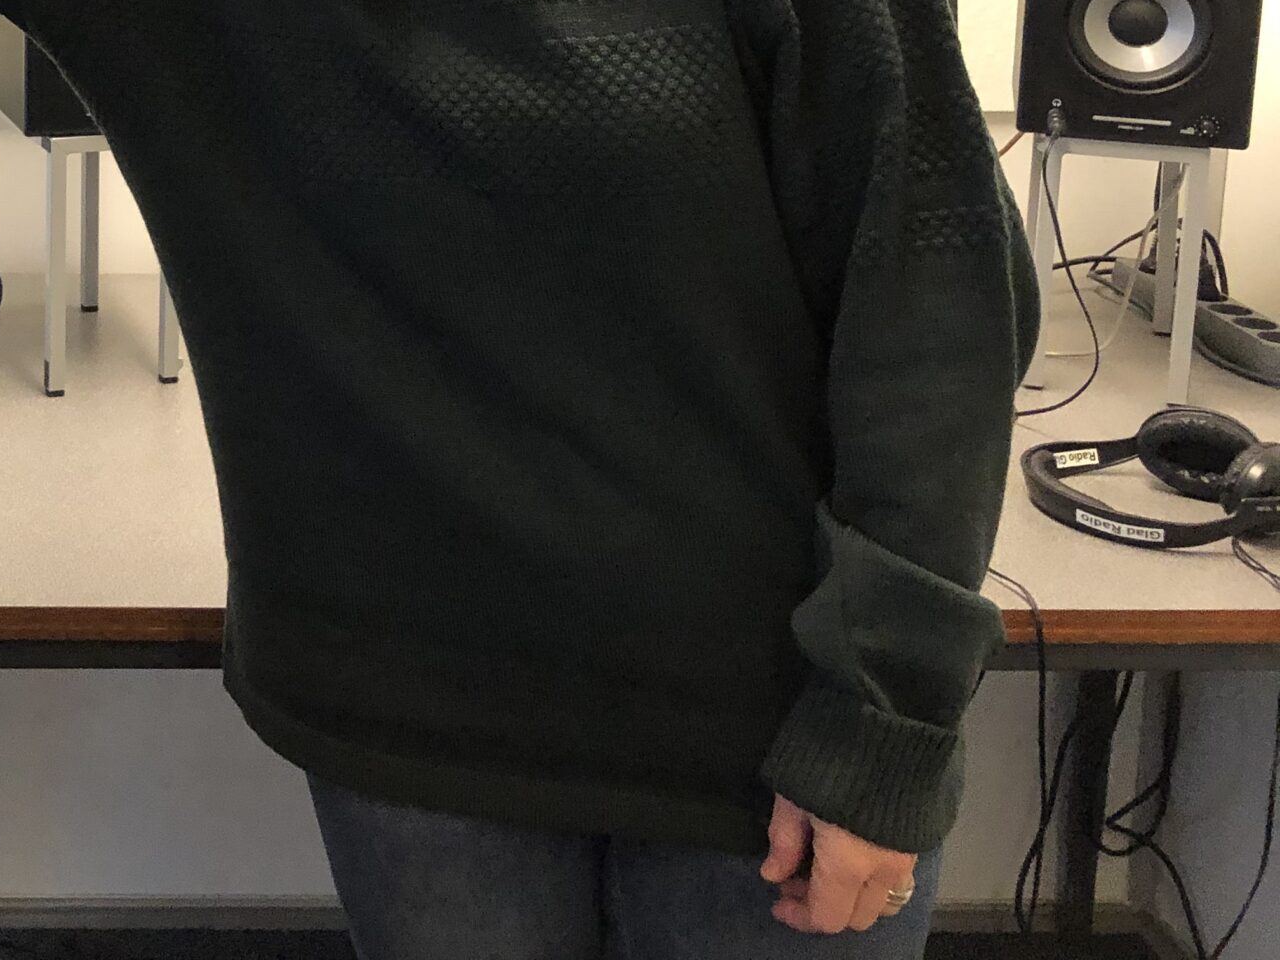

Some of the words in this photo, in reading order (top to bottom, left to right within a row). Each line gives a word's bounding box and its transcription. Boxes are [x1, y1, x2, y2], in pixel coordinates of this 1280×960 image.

[1069, 451, 1096, 463] Radio
[1081, 512, 1122, 535] Radio
[1127, 527, 1161, 540] Glad
